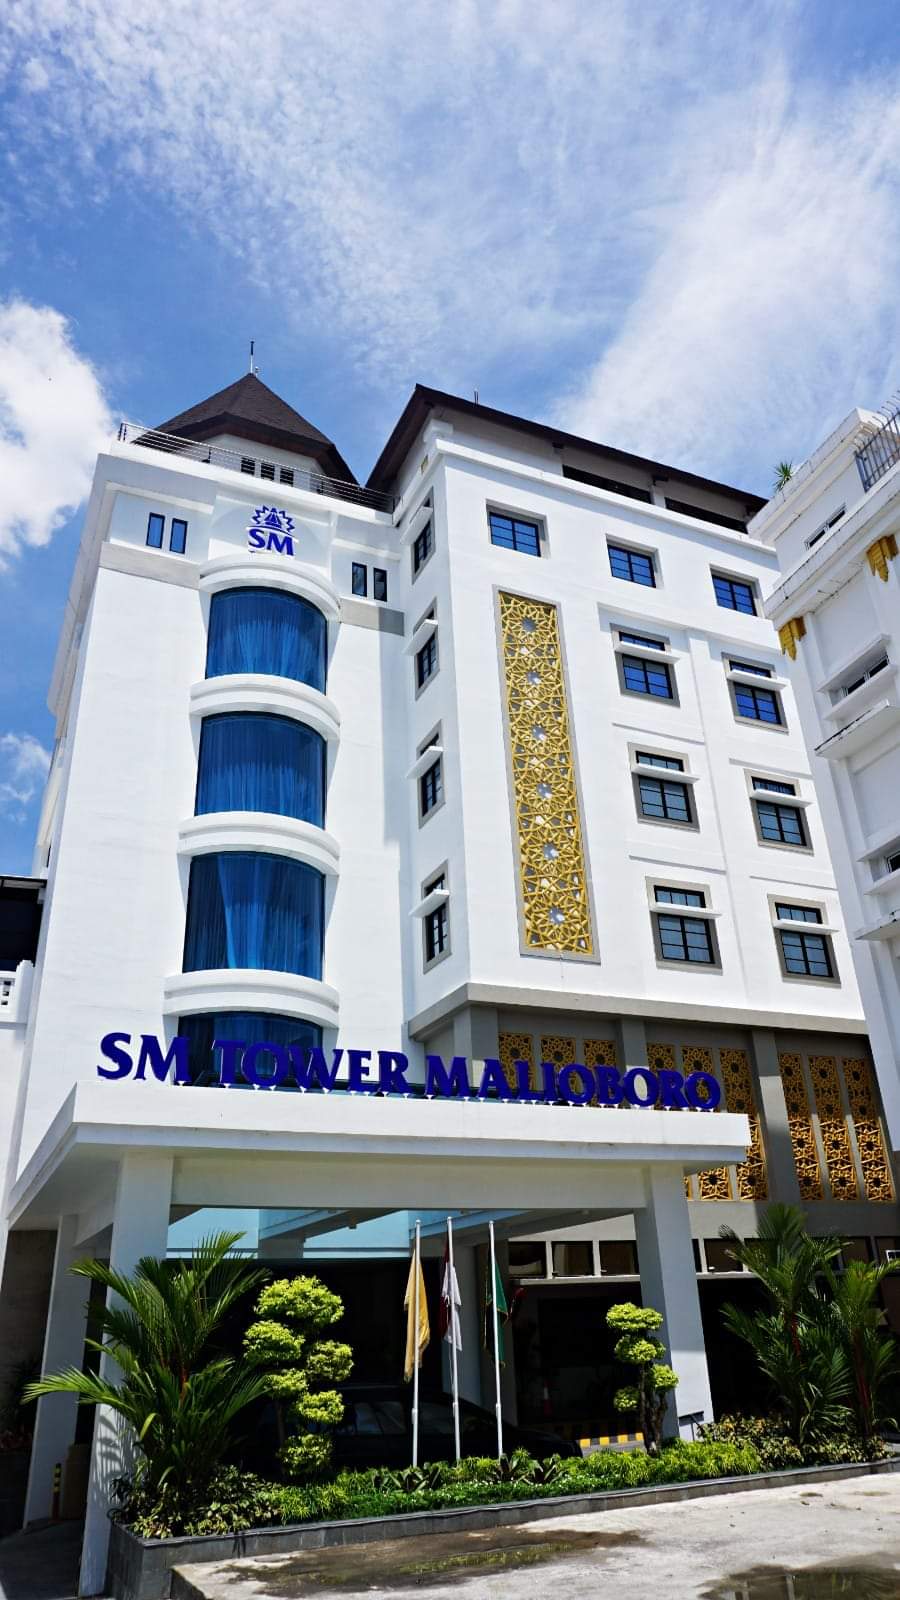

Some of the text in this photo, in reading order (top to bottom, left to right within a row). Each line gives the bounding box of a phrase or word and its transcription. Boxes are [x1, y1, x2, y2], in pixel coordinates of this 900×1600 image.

[248, 528, 294, 556] SM
[96, 1032, 721, 1110] SM TOWER MALIOBORO
